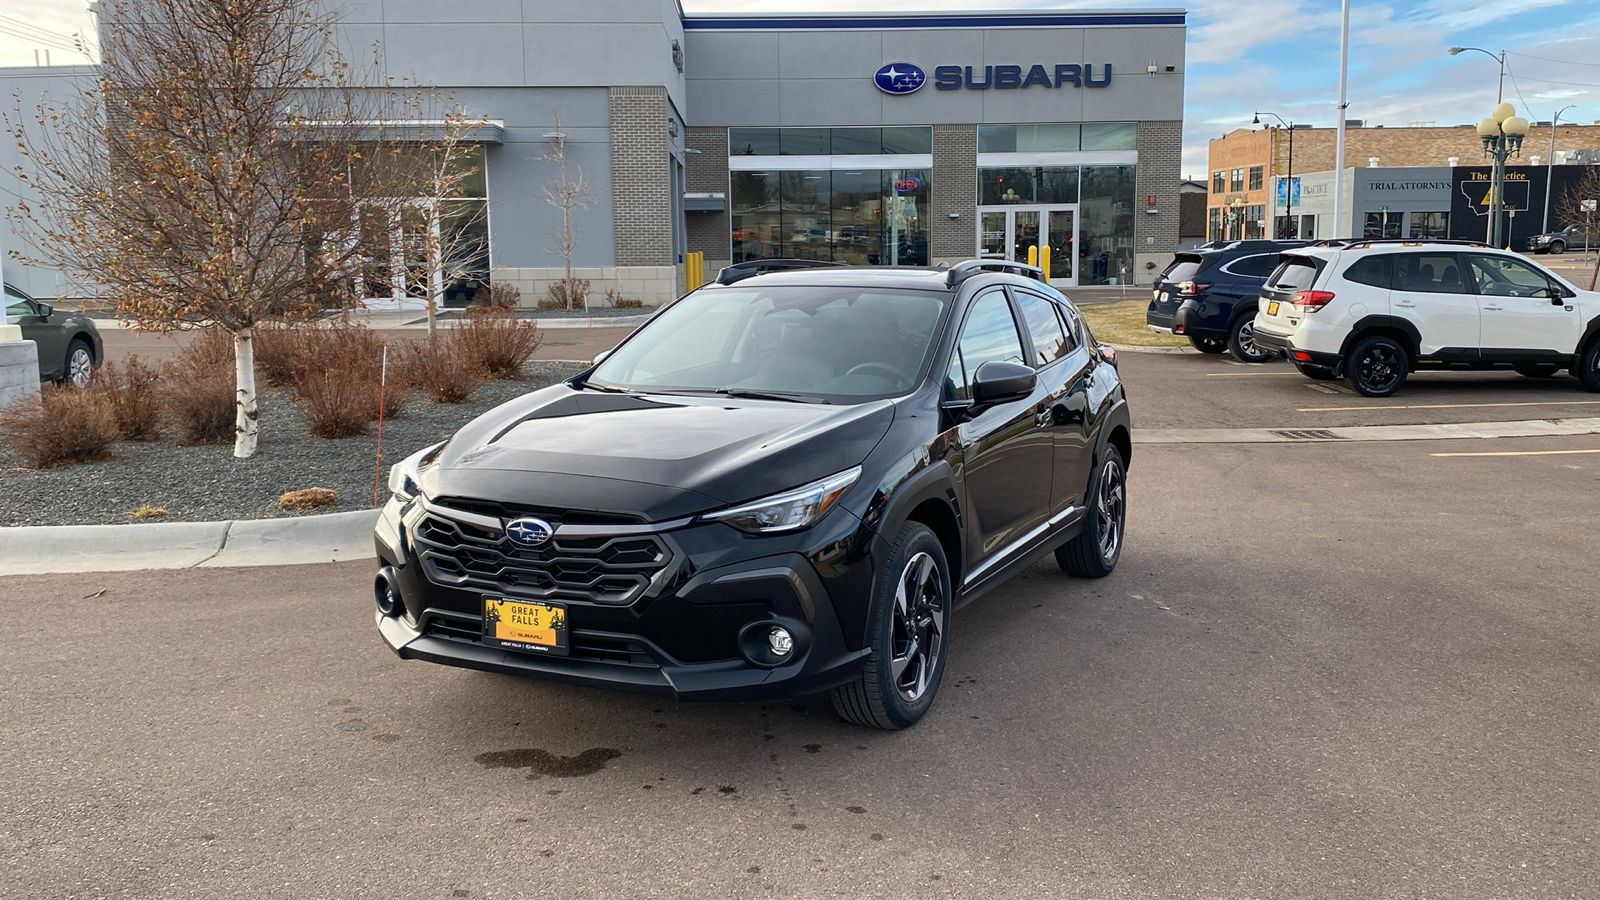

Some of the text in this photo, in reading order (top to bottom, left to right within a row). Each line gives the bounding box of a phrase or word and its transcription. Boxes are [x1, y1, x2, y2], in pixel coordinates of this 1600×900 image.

[934, 62, 1112, 90] SUBARU
[1470, 171, 1488, 180] The
[1303, 184, 1328, 195] PRACTICE
[1369, 182, 1452, 190] TRIAL ATTORNEYS
[512, 606, 538, 616] GREAT
[512, 615, 539, 626] FALLS
